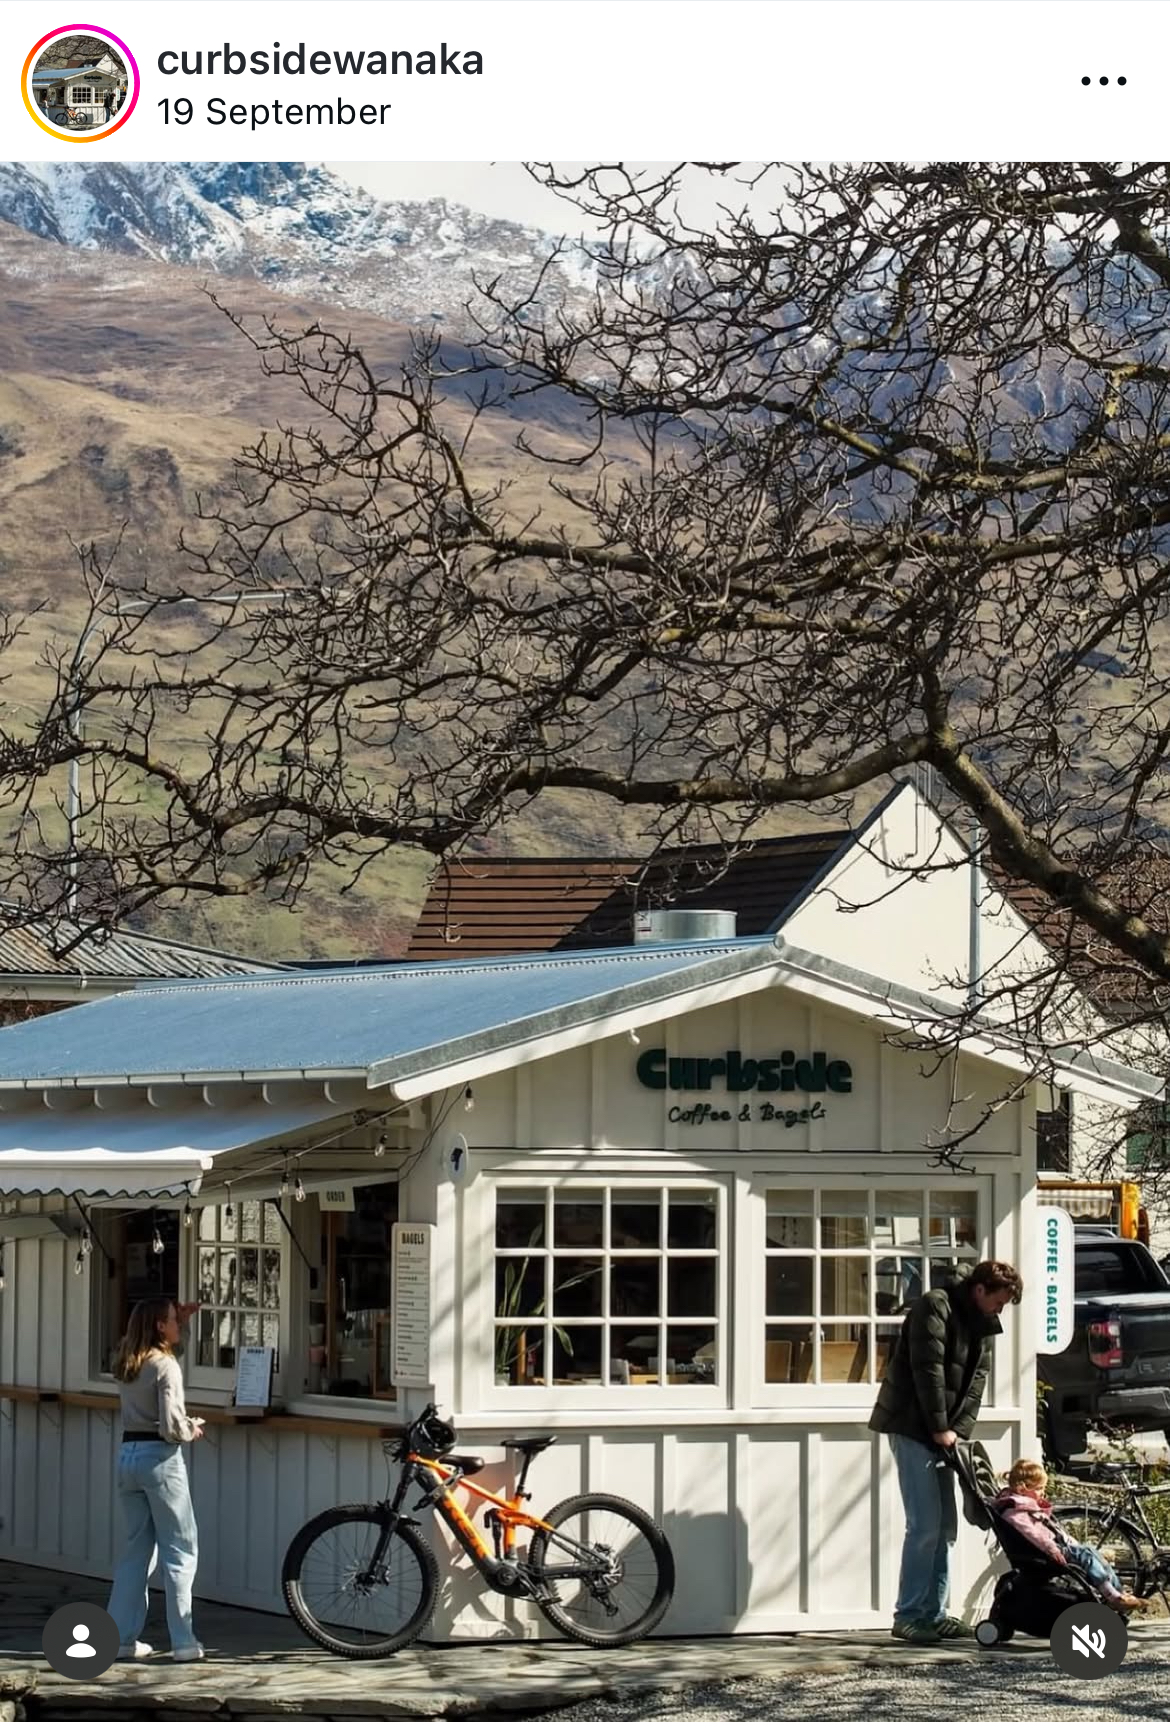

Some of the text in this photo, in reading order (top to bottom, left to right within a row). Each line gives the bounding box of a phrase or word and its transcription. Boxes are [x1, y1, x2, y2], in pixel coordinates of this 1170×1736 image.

[636, 1048, 853, 1093] Curbside
[668, 1101, 827, 1128] Coffee & Bagels
[401, 1232, 425, 1246] BAGELS
[1046, 1217, 1059, 1274] COFFEE
[1046, 1284, 1059, 1343] BAGELS
